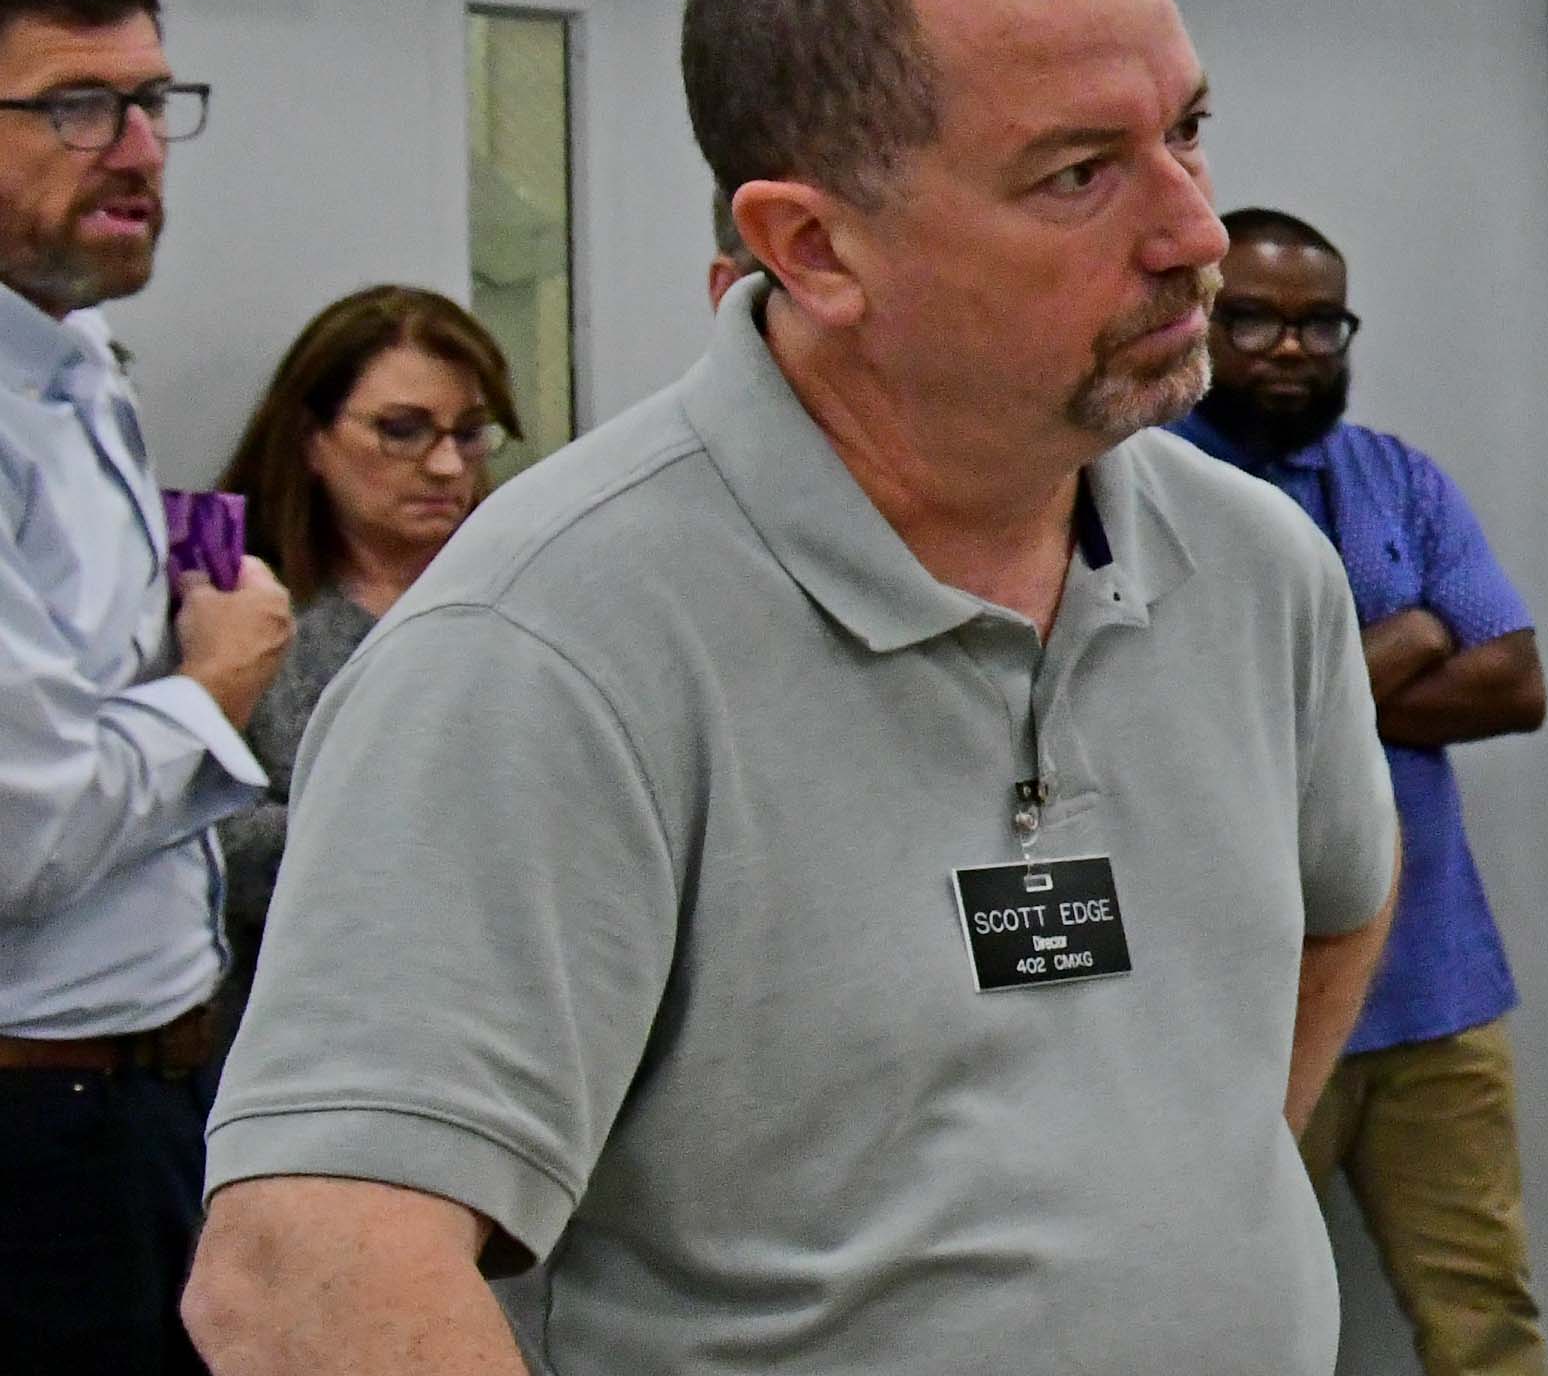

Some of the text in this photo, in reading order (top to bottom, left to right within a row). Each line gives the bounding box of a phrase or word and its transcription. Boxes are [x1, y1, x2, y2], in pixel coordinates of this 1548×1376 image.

[974, 899, 1114, 935] SCOTT EDGE
[1016, 951, 1094, 974] 402 CMXG
